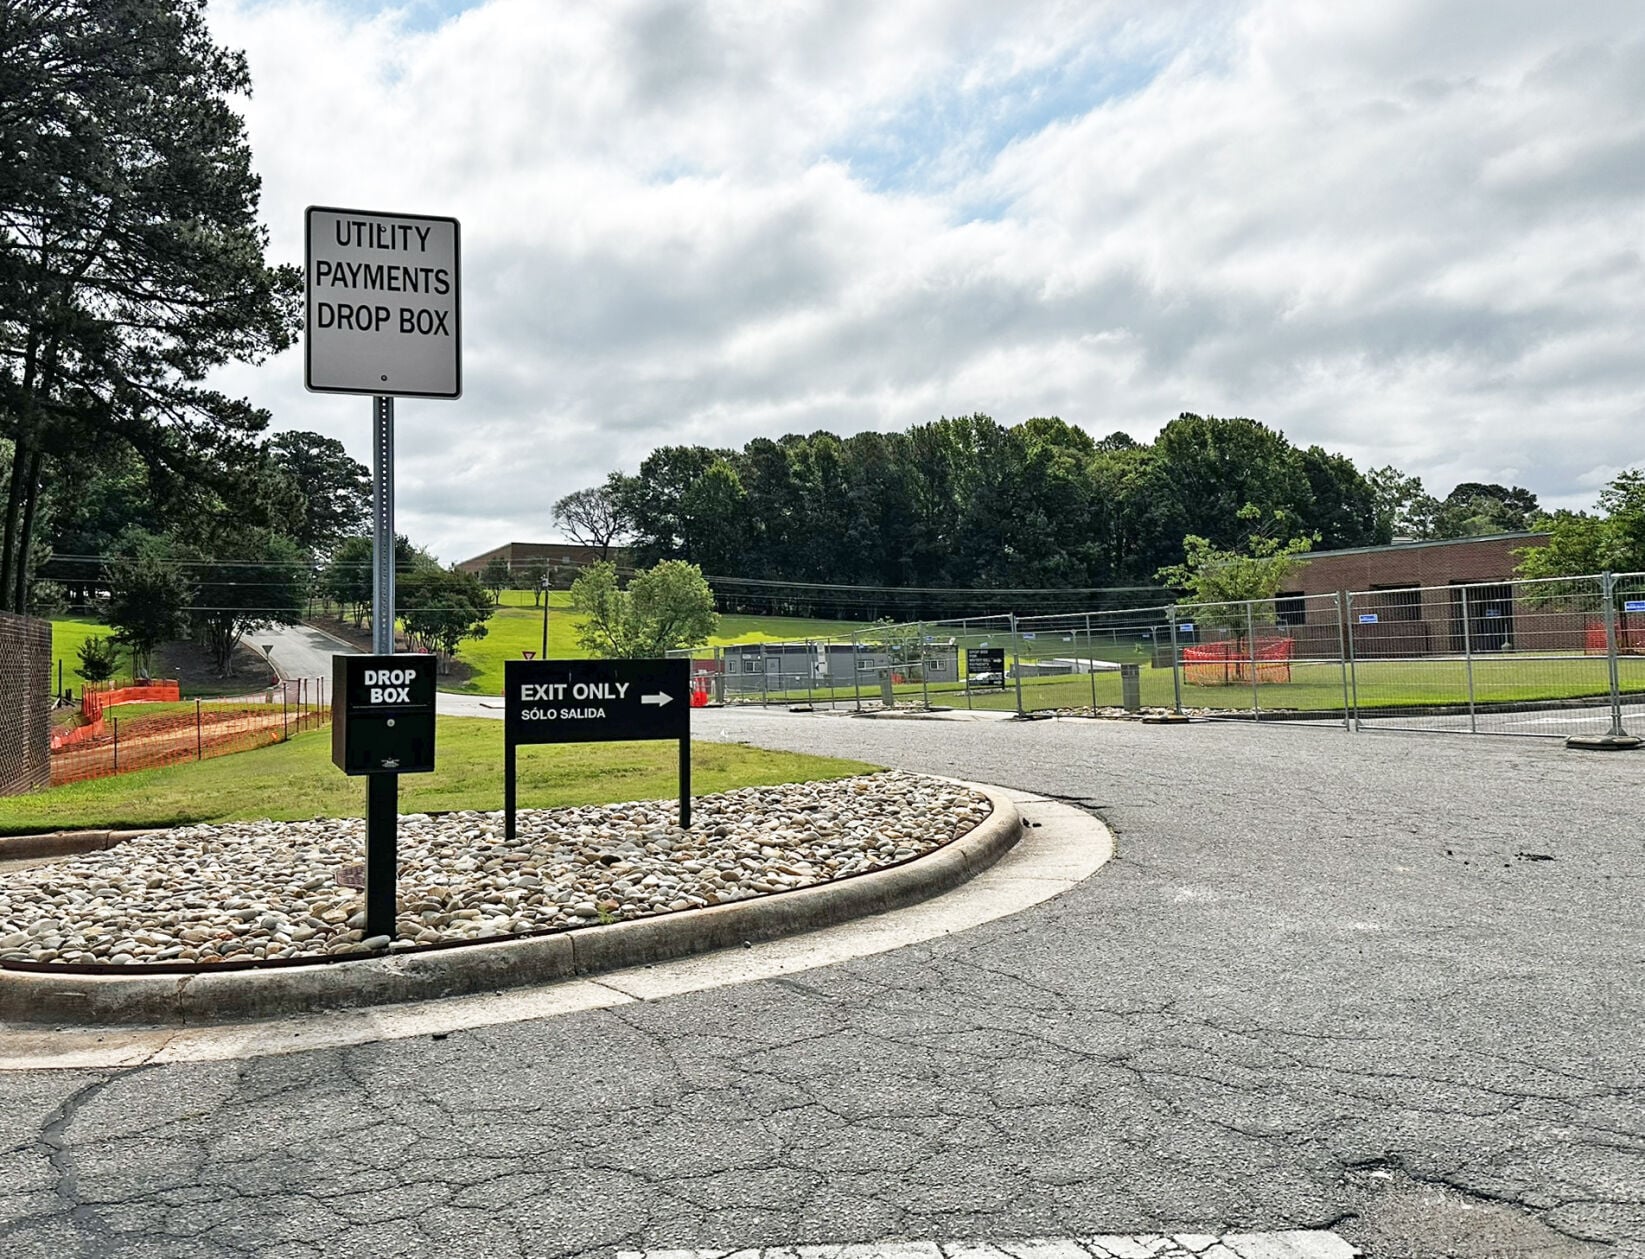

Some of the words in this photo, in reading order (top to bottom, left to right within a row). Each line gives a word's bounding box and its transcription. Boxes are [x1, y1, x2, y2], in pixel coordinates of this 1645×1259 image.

[336, 220, 431, 252] UTILITY
[316, 260, 450, 295] PAYMENTS
[317, 302, 391, 332] DROP
[400, 307, 449, 336] BOX
[364, 669, 417, 686] DROP
[370, 687, 410, 704] BOX
[521, 684, 567, 701] EXIT
[572, 682, 630, 700] ONLY
[521, 707, 557, 721] SÓLO
[560, 707, 606, 720] SALIDA
